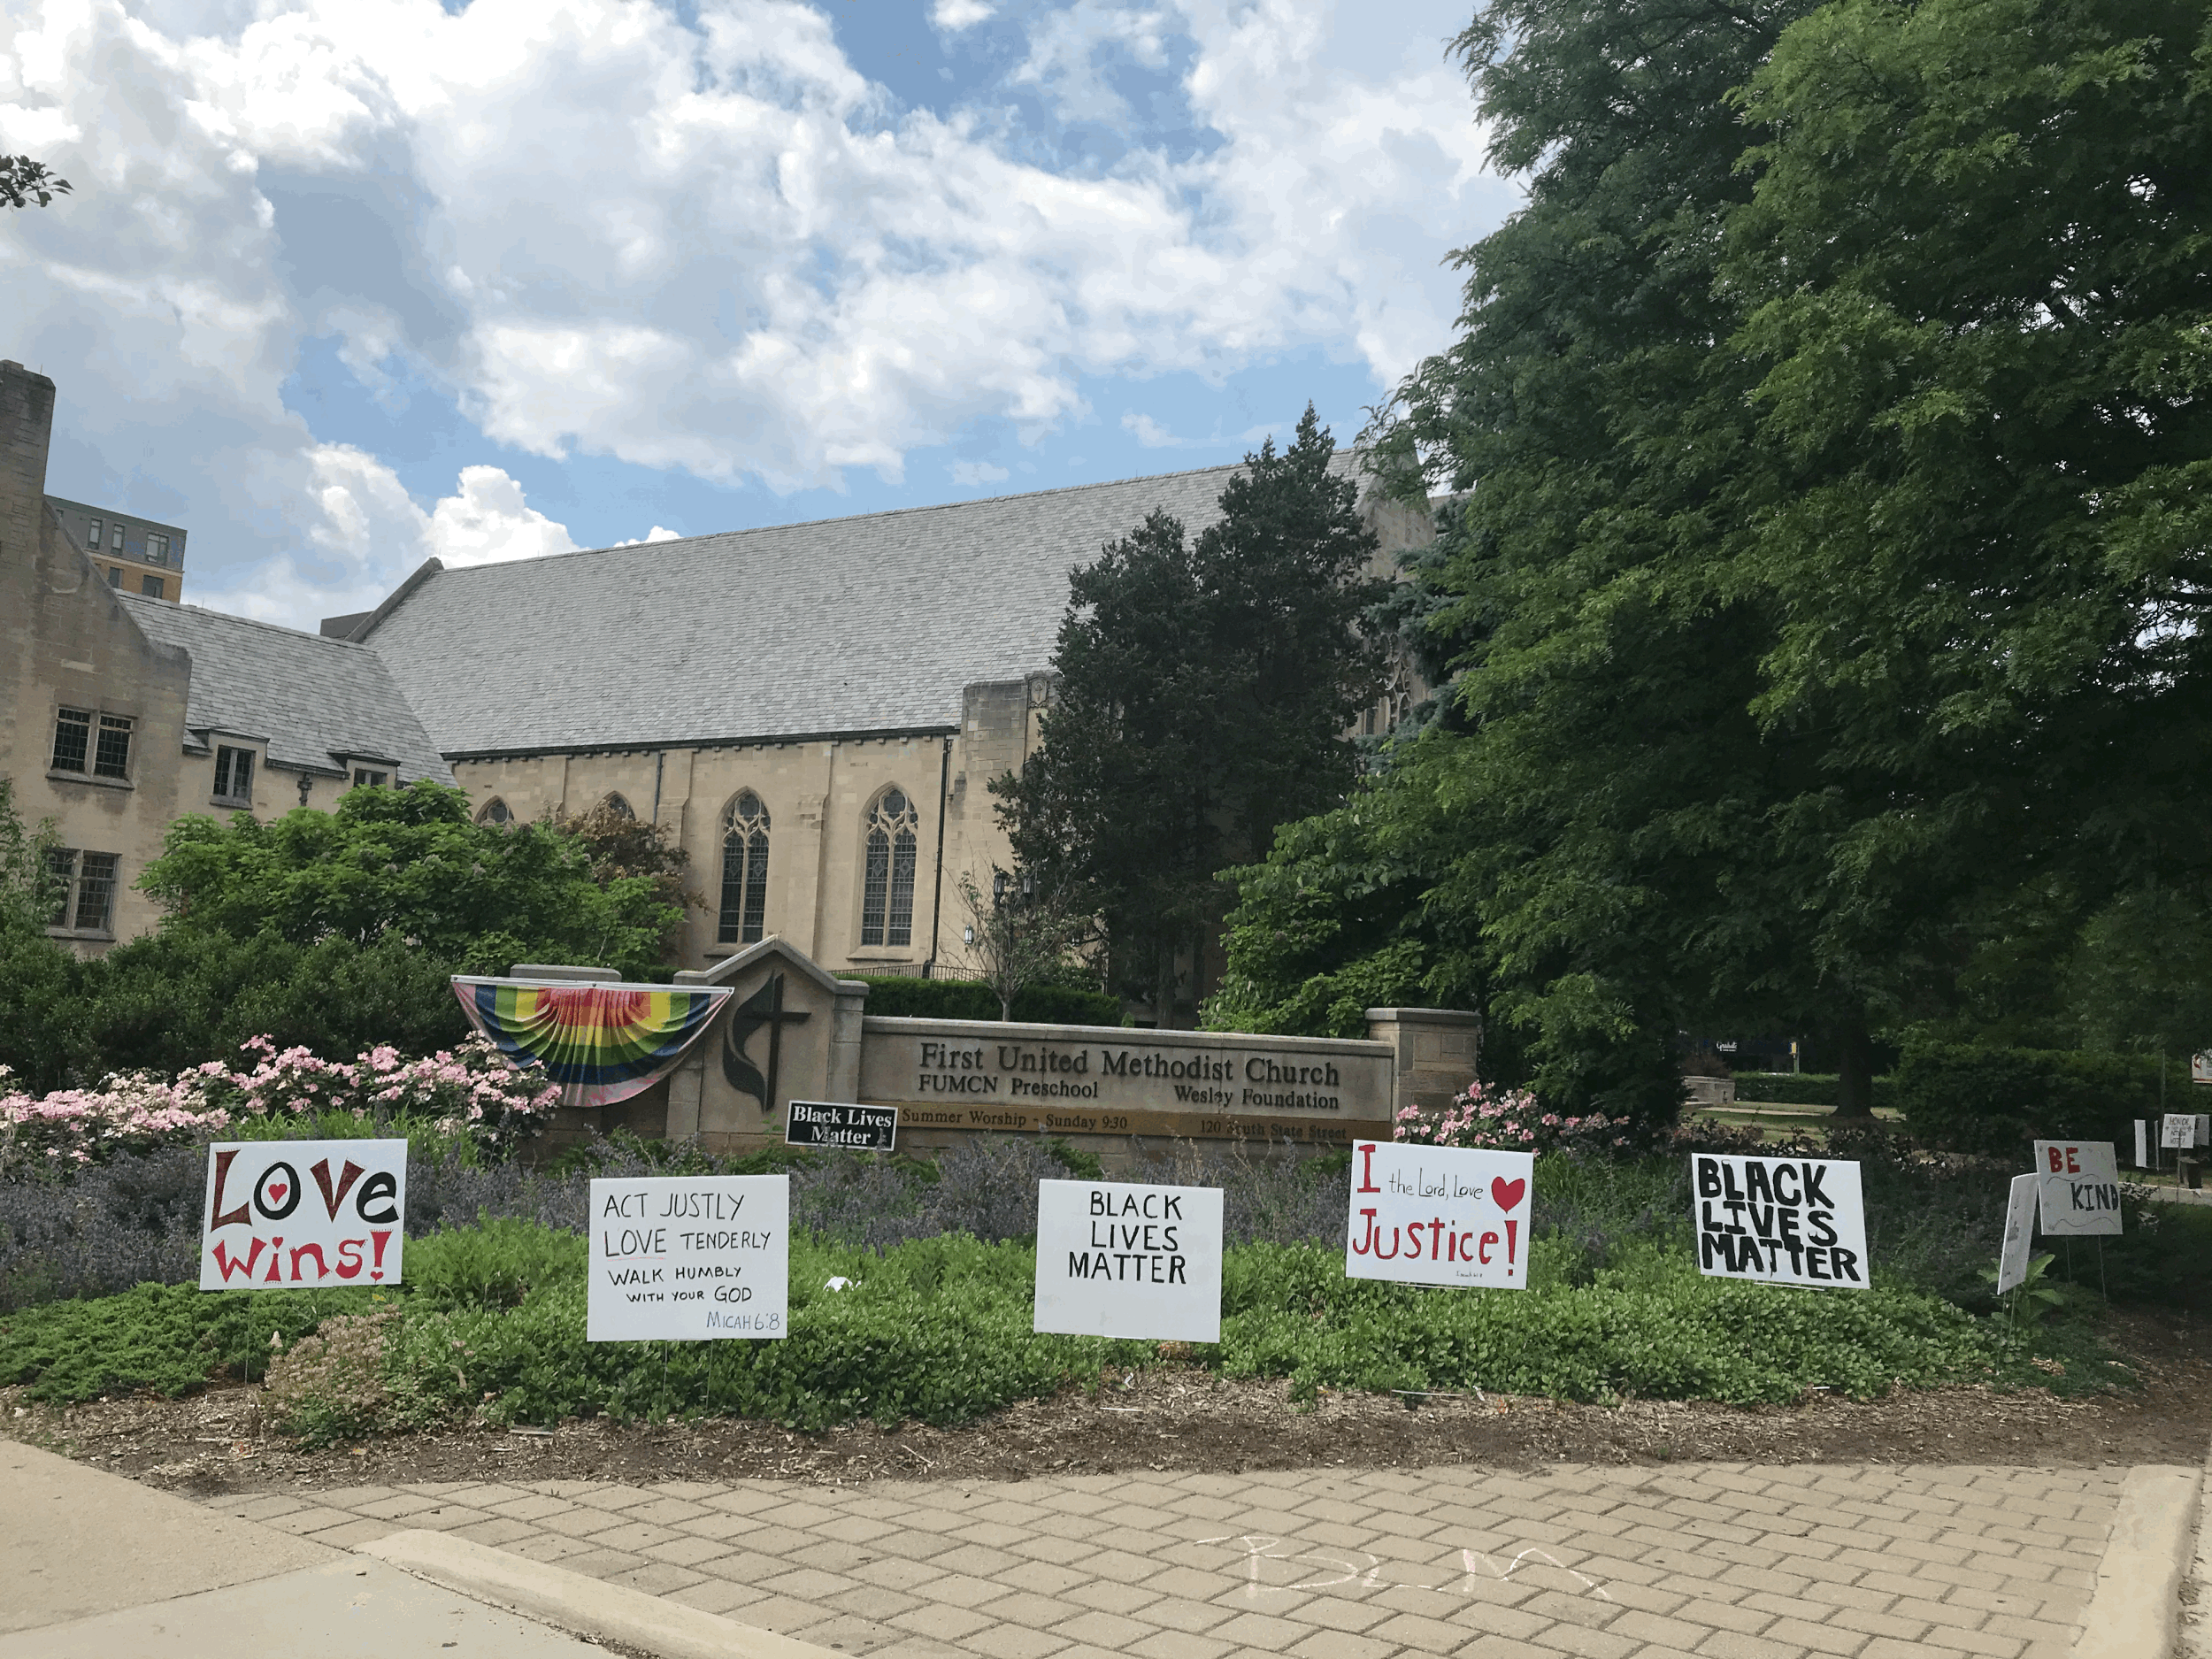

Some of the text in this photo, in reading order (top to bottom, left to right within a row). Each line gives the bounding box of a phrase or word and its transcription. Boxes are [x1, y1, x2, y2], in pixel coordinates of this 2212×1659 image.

[919, 1042, 1340, 1086] First United Methodist Church
[918, 1074, 1098, 1098] FUMCN Preschool
[1174, 1086, 1340, 1110] Wesley Foundation
[792, 1105, 892, 1128] Black Lives
[902, 1109, 963, 1124] Summer
[969, 1110, 1027, 1127] Worship
[1045, 1113, 1096, 1131] Sunday
[1102, 1116, 1128, 1129] 9:30
[1201, 1119, 1222, 1133] 120
[1270, 1123, 1303, 1138] State
[1309, 1125, 1347, 1140] Street
[810, 1125, 872, 1145] Matter
[1356, 1144, 1380, 1193] I
[1388, 1168, 1414, 1195] the
[1418, 1167, 1449, 1200] Lord,
[2047, 1146, 2081, 1174] BE
[1698, 1157, 1835, 1210] BLACK
[2070, 1182, 2119, 1211] KIND
[603, 1192, 745, 1221] ACT JUSTLY
[1089, 1190, 1183, 1221] BLACK
[1091, 1220, 1179, 1252] LIVES
[1701, 1200, 1839, 1248] LIVES
[604, 1228, 771, 1257] LOVE TENDERLY
[1701, 1232, 1862, 1282] MATTER
[607, 1265, 741, 1286] WALK HUMBLY
[1069, 1251, 1187, 1285] MATTER
[626, 1286, 752, 1303] WITH YOUR GOD
[754, 1312, 780, 1331] 6:8
